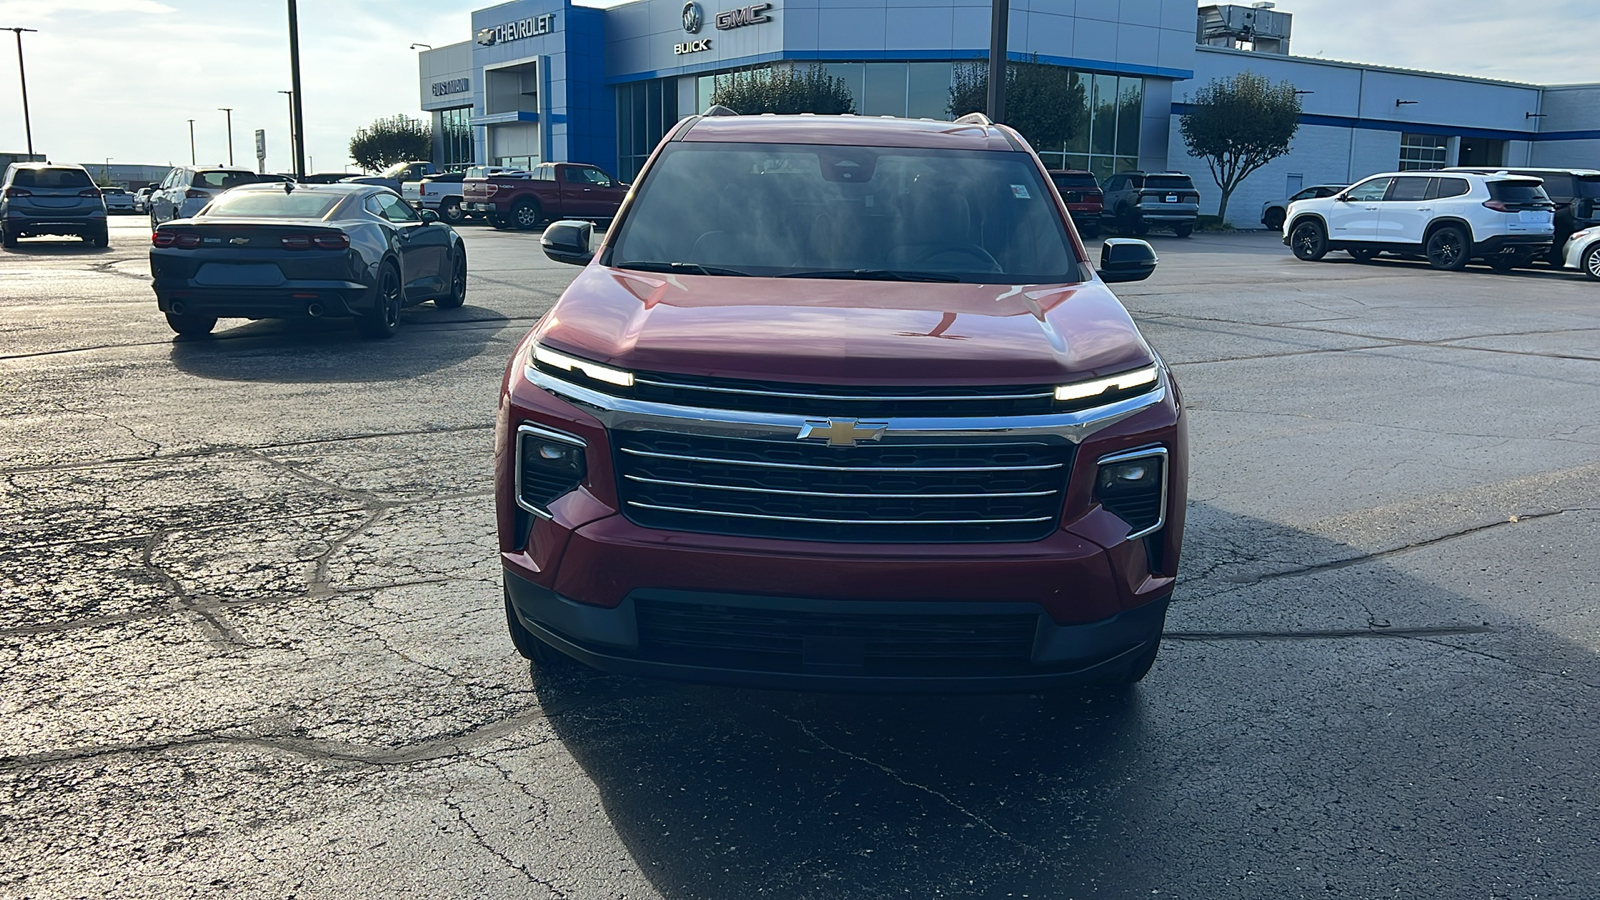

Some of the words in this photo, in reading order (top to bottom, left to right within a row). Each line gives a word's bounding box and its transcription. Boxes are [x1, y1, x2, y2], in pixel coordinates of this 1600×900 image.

[495, 13, 553, 43] CHEVROLET
[715, 4, 771, 30] GMC
[673, 39, 710, 54] BUICK
[432, 78, 468, 96] GUSTMAN
